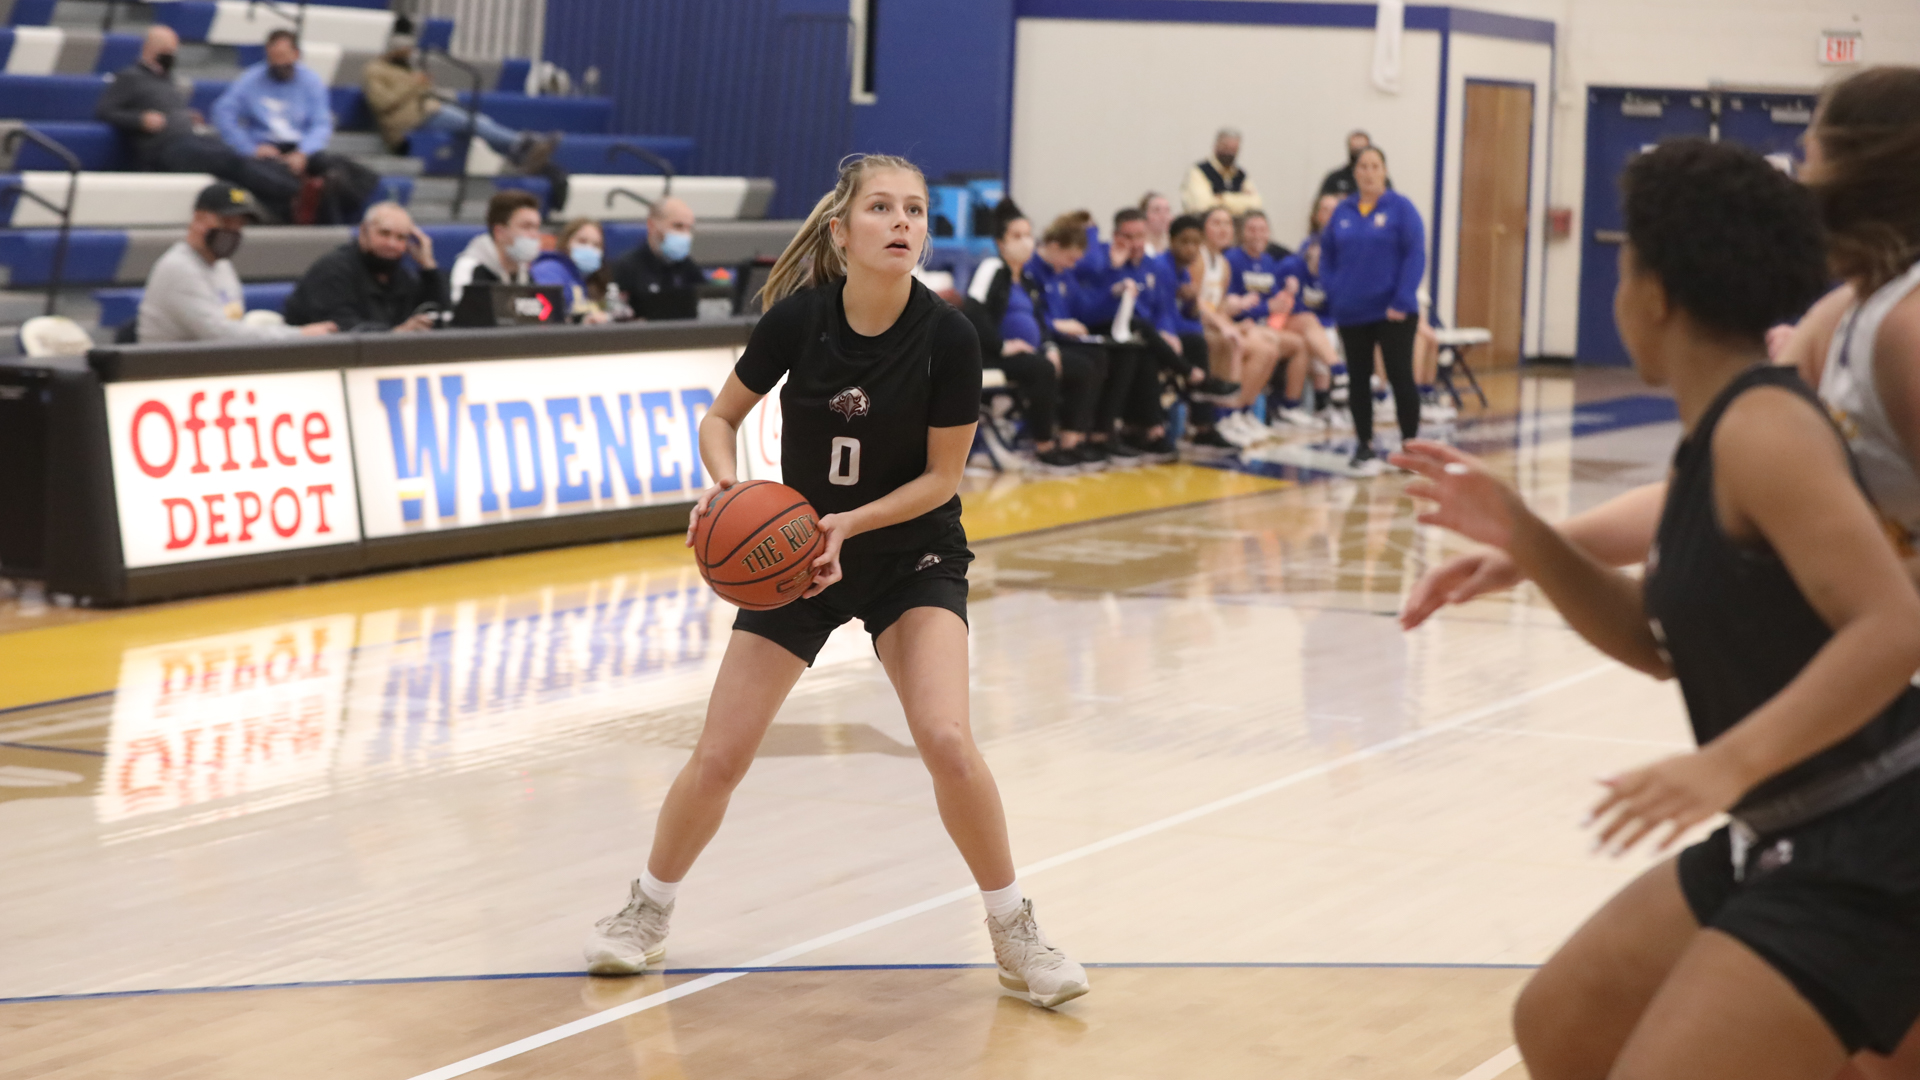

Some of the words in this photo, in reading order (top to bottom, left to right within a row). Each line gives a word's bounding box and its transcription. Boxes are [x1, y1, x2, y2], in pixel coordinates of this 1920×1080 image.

[130, 390, 332, 479] Office
[828, 436, 861, 486] 0
[161, 484, 334, 550] DEPOT
[741, 534, 785, 574] THE
